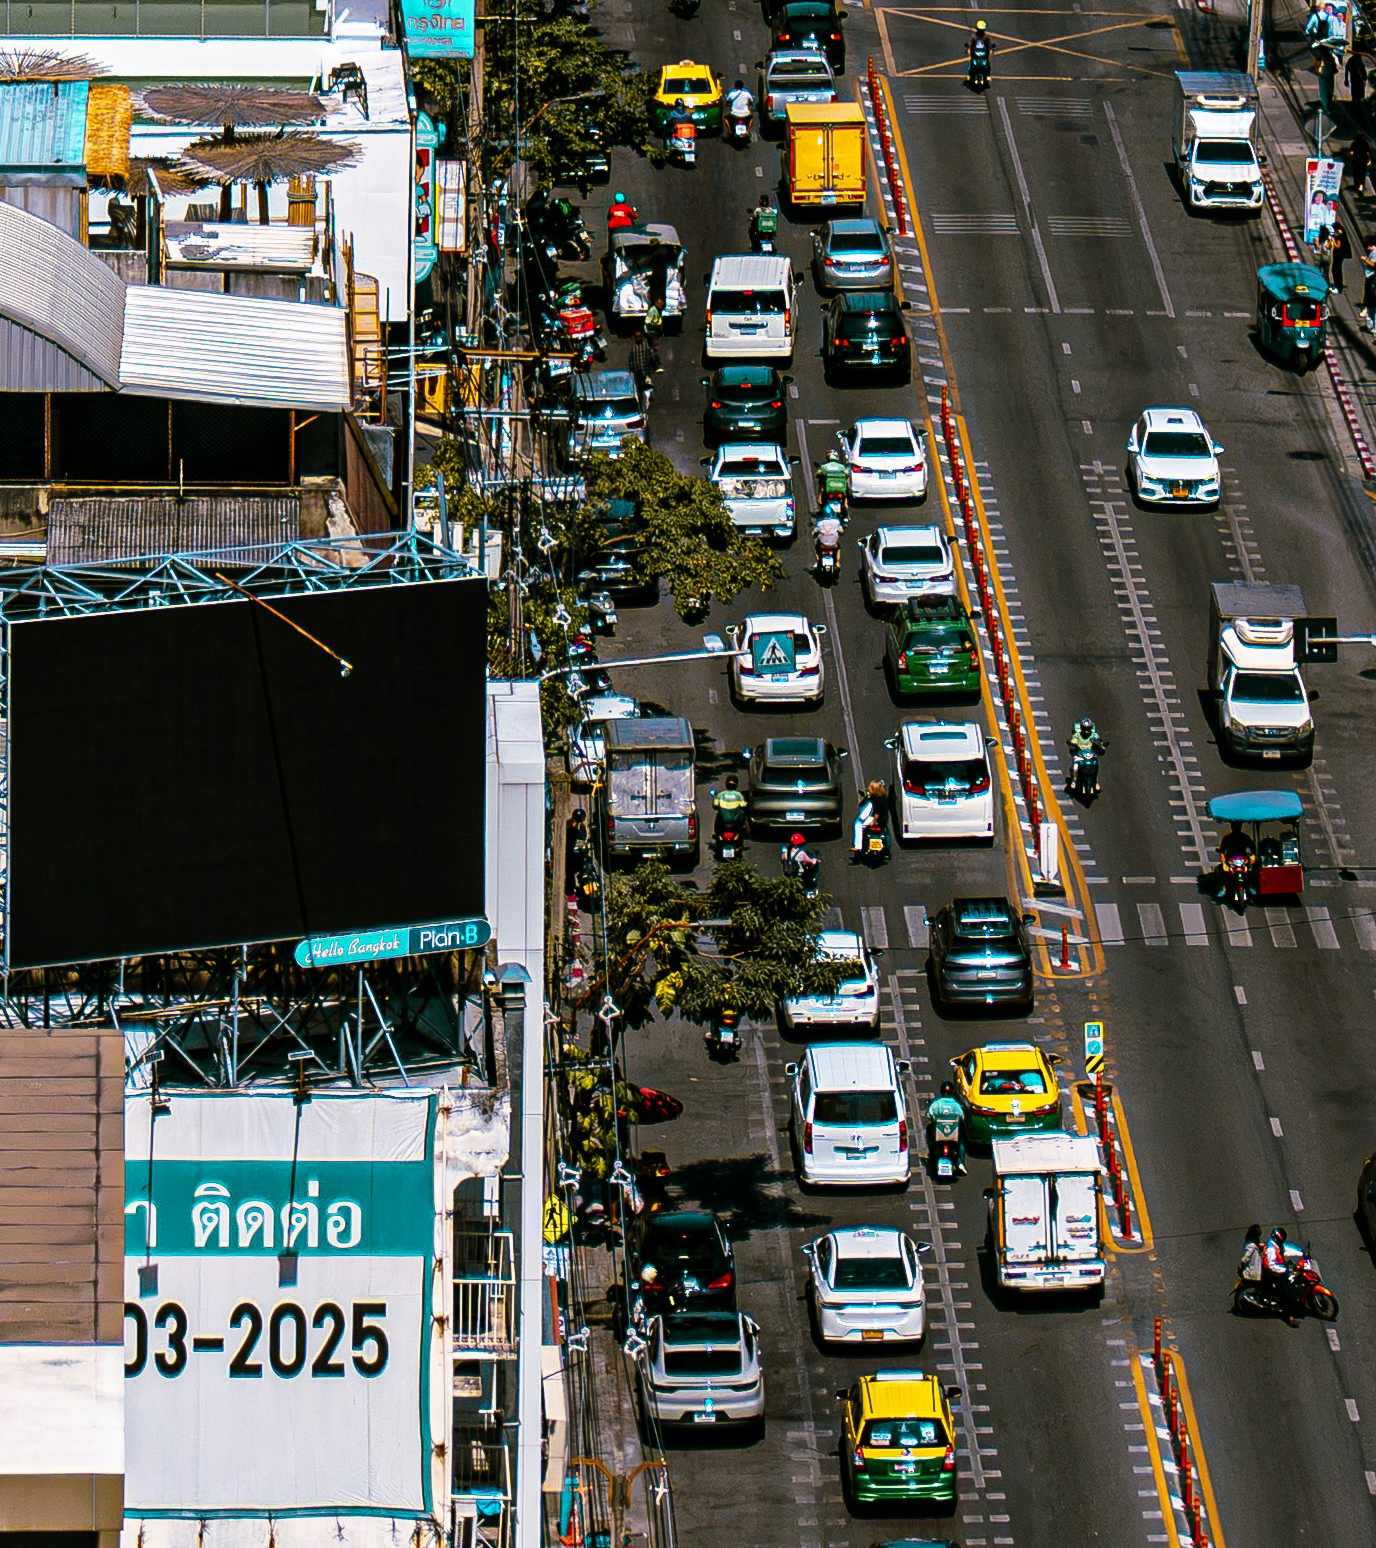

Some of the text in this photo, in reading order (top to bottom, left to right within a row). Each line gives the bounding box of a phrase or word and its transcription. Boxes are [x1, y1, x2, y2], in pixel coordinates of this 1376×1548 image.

[407, 13, 465, 34] กรุงไทย
[304, 940, 344, 964] Hello
[347, 933, 400, 956] Bangkok
[192, 1180, 363, 1250] ติดต่อ
